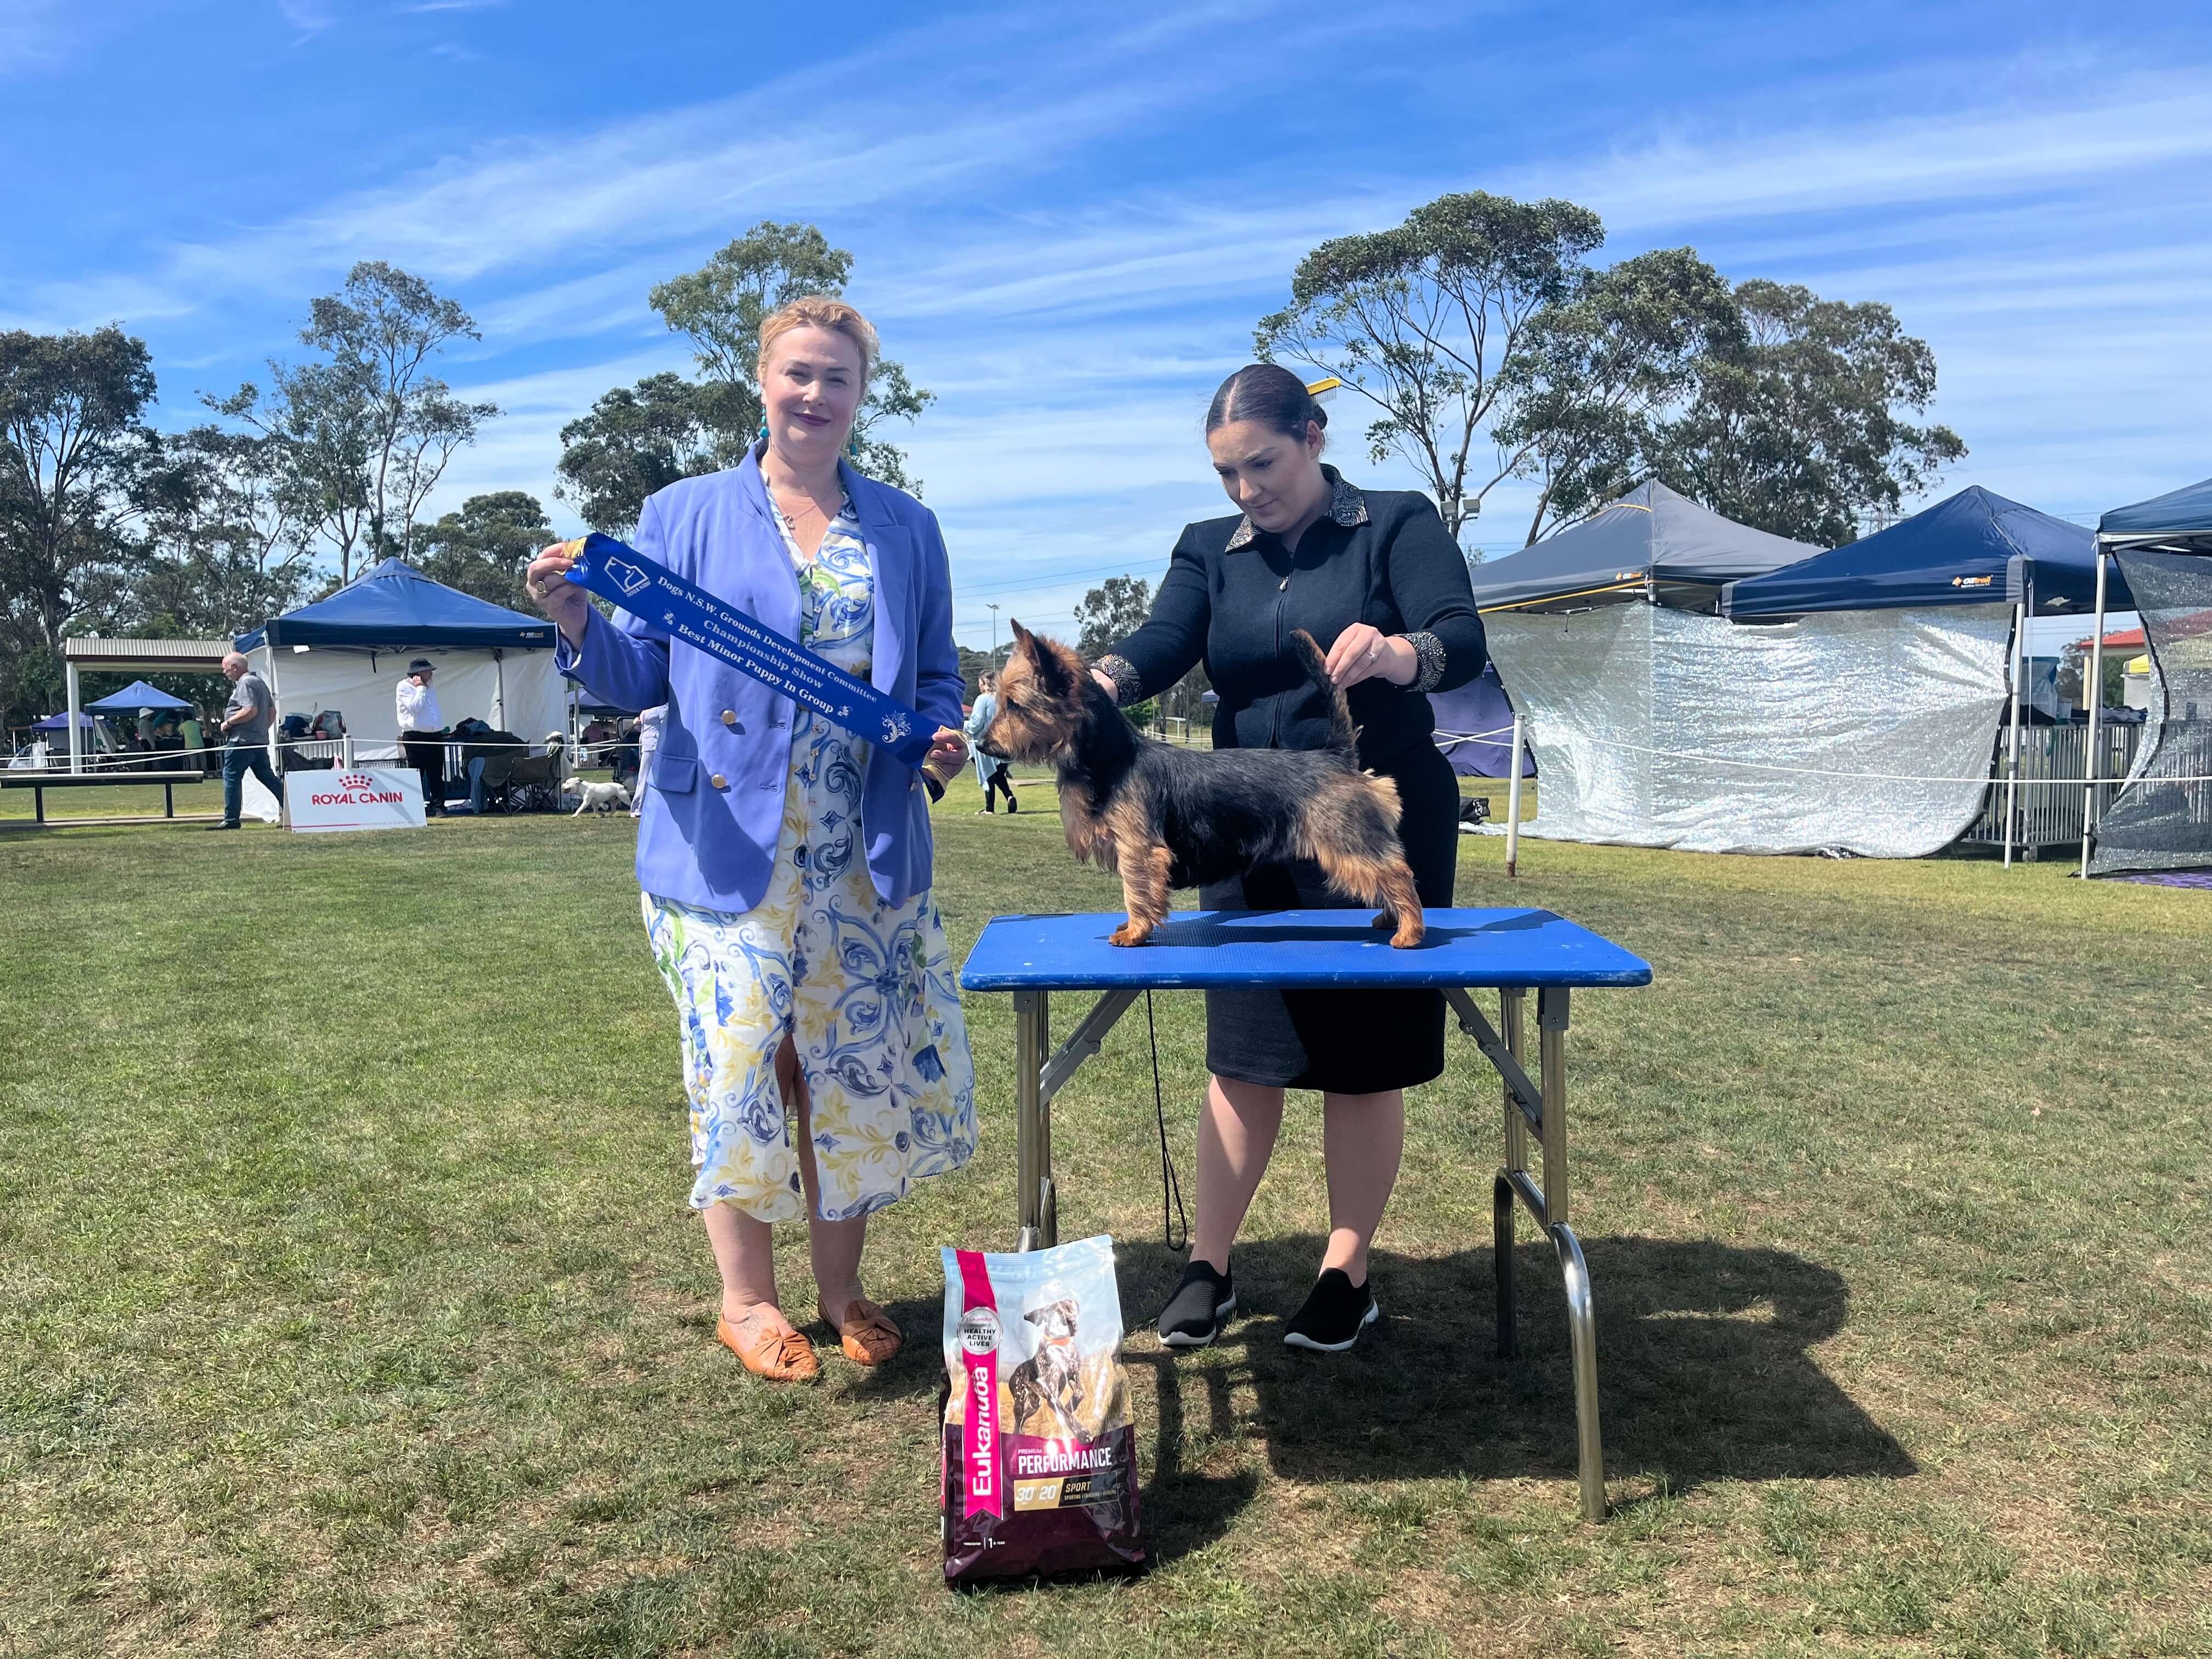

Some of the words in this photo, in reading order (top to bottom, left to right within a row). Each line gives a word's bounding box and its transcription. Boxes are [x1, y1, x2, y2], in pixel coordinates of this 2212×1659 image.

[658, 576, 684, 596] Dogs
[685, 592, 717, 616] N.S.W.
[720, 612, 761, 640] Grounds
[763, 635, 826, 675] Development
[827, 671, 877, 703] Committee
[678, 623, 706, 644] Best
[707, 640, 743, 664] Minor
[746, 659, 782, 685] Puppy
[783, 680, 797, 693] In
[799, 689, 834, 714] Group
[703, 620, 789, 671] Championship
[792, 667, 823, 689] Show
[312, 793, 356, 805] ROYAL
[359, 792, 403, 804] CANIN
[973, 1366, 991, 1496] Eukanuba
[1018, 1447, 1113, 1475] PERFORMANCE
[1065, 1481, 1092, 1493] SPORT
